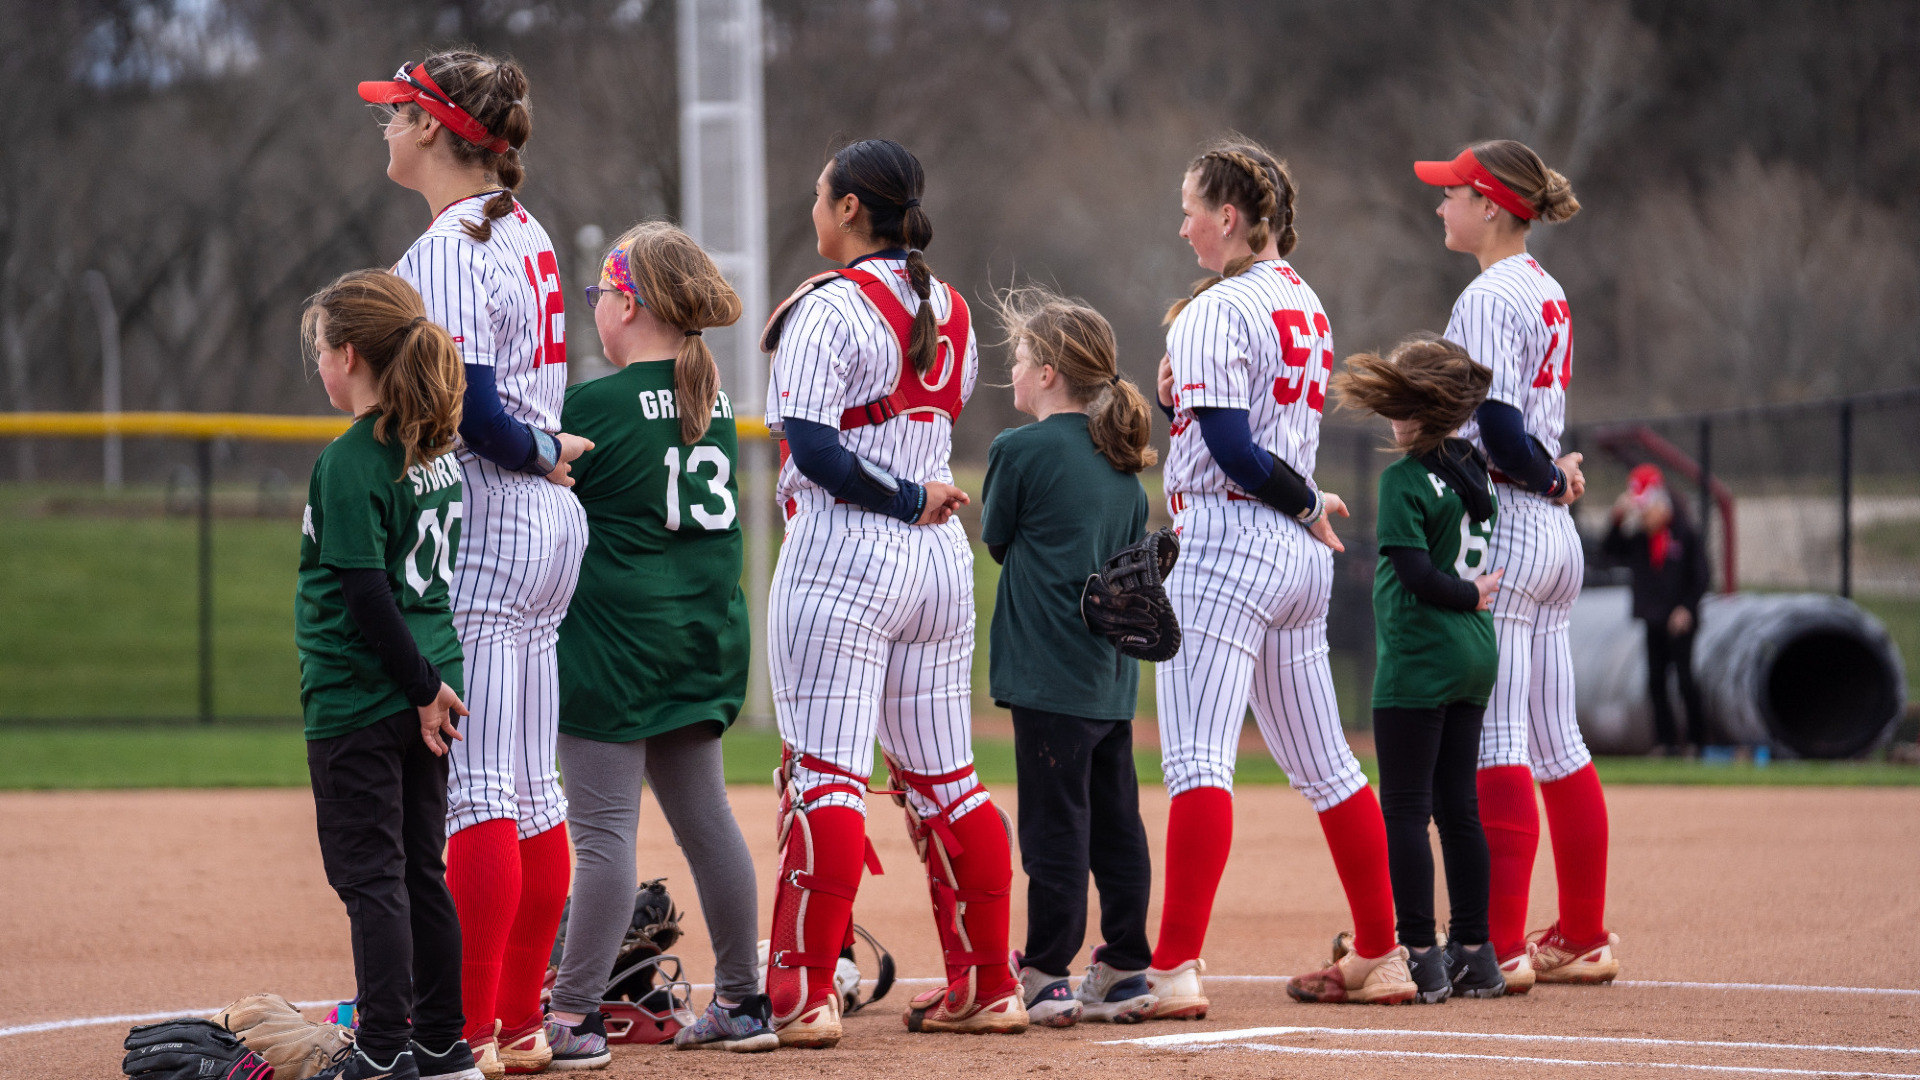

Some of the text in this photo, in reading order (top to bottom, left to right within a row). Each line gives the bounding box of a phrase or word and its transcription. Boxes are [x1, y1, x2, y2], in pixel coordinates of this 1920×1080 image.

[523, 250, 567, 368] 12
[1532, 299, 1573, 391] 27
[1271, 309, 1334, 414] 53
[664, 446, 736, 531] 13
[1454, 511, 1492, 581] 6
